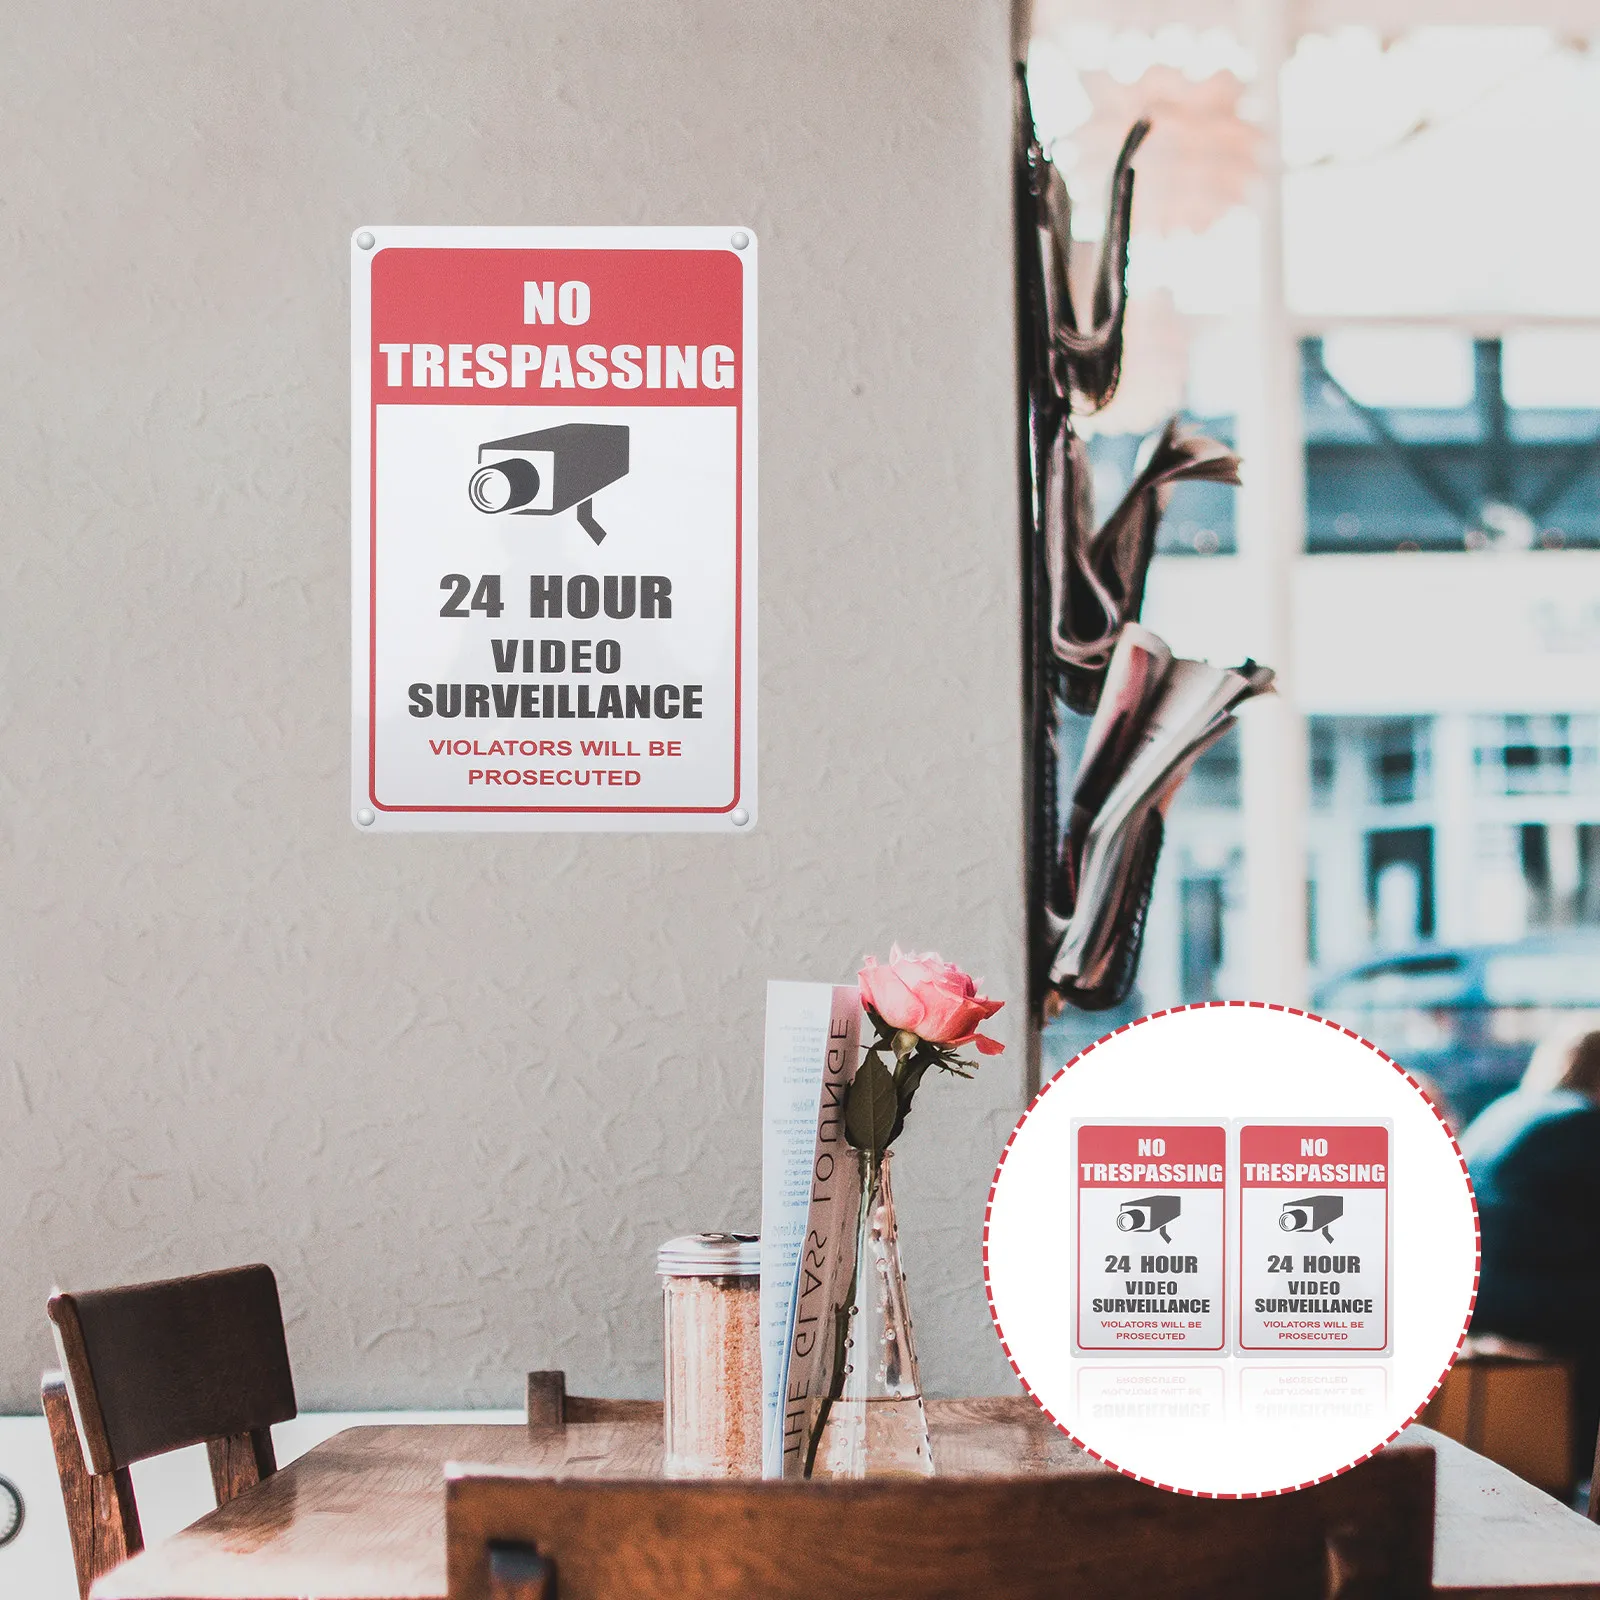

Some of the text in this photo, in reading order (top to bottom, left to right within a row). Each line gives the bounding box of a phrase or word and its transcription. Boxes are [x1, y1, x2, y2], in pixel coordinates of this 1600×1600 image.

[524, 281, 590, 325] NO
[380, 344, 734, 389] TRESPASSING
[440, 574, 671, 619] 24 HOUR
[491, 640, 620, 674] VIDEO
[409, 683, 702, 719] SURVEILLANCE
[429, 740, 682, 756] VIOLATORS WILL BE
[469, 770, 640, 786] PROSECUTED
